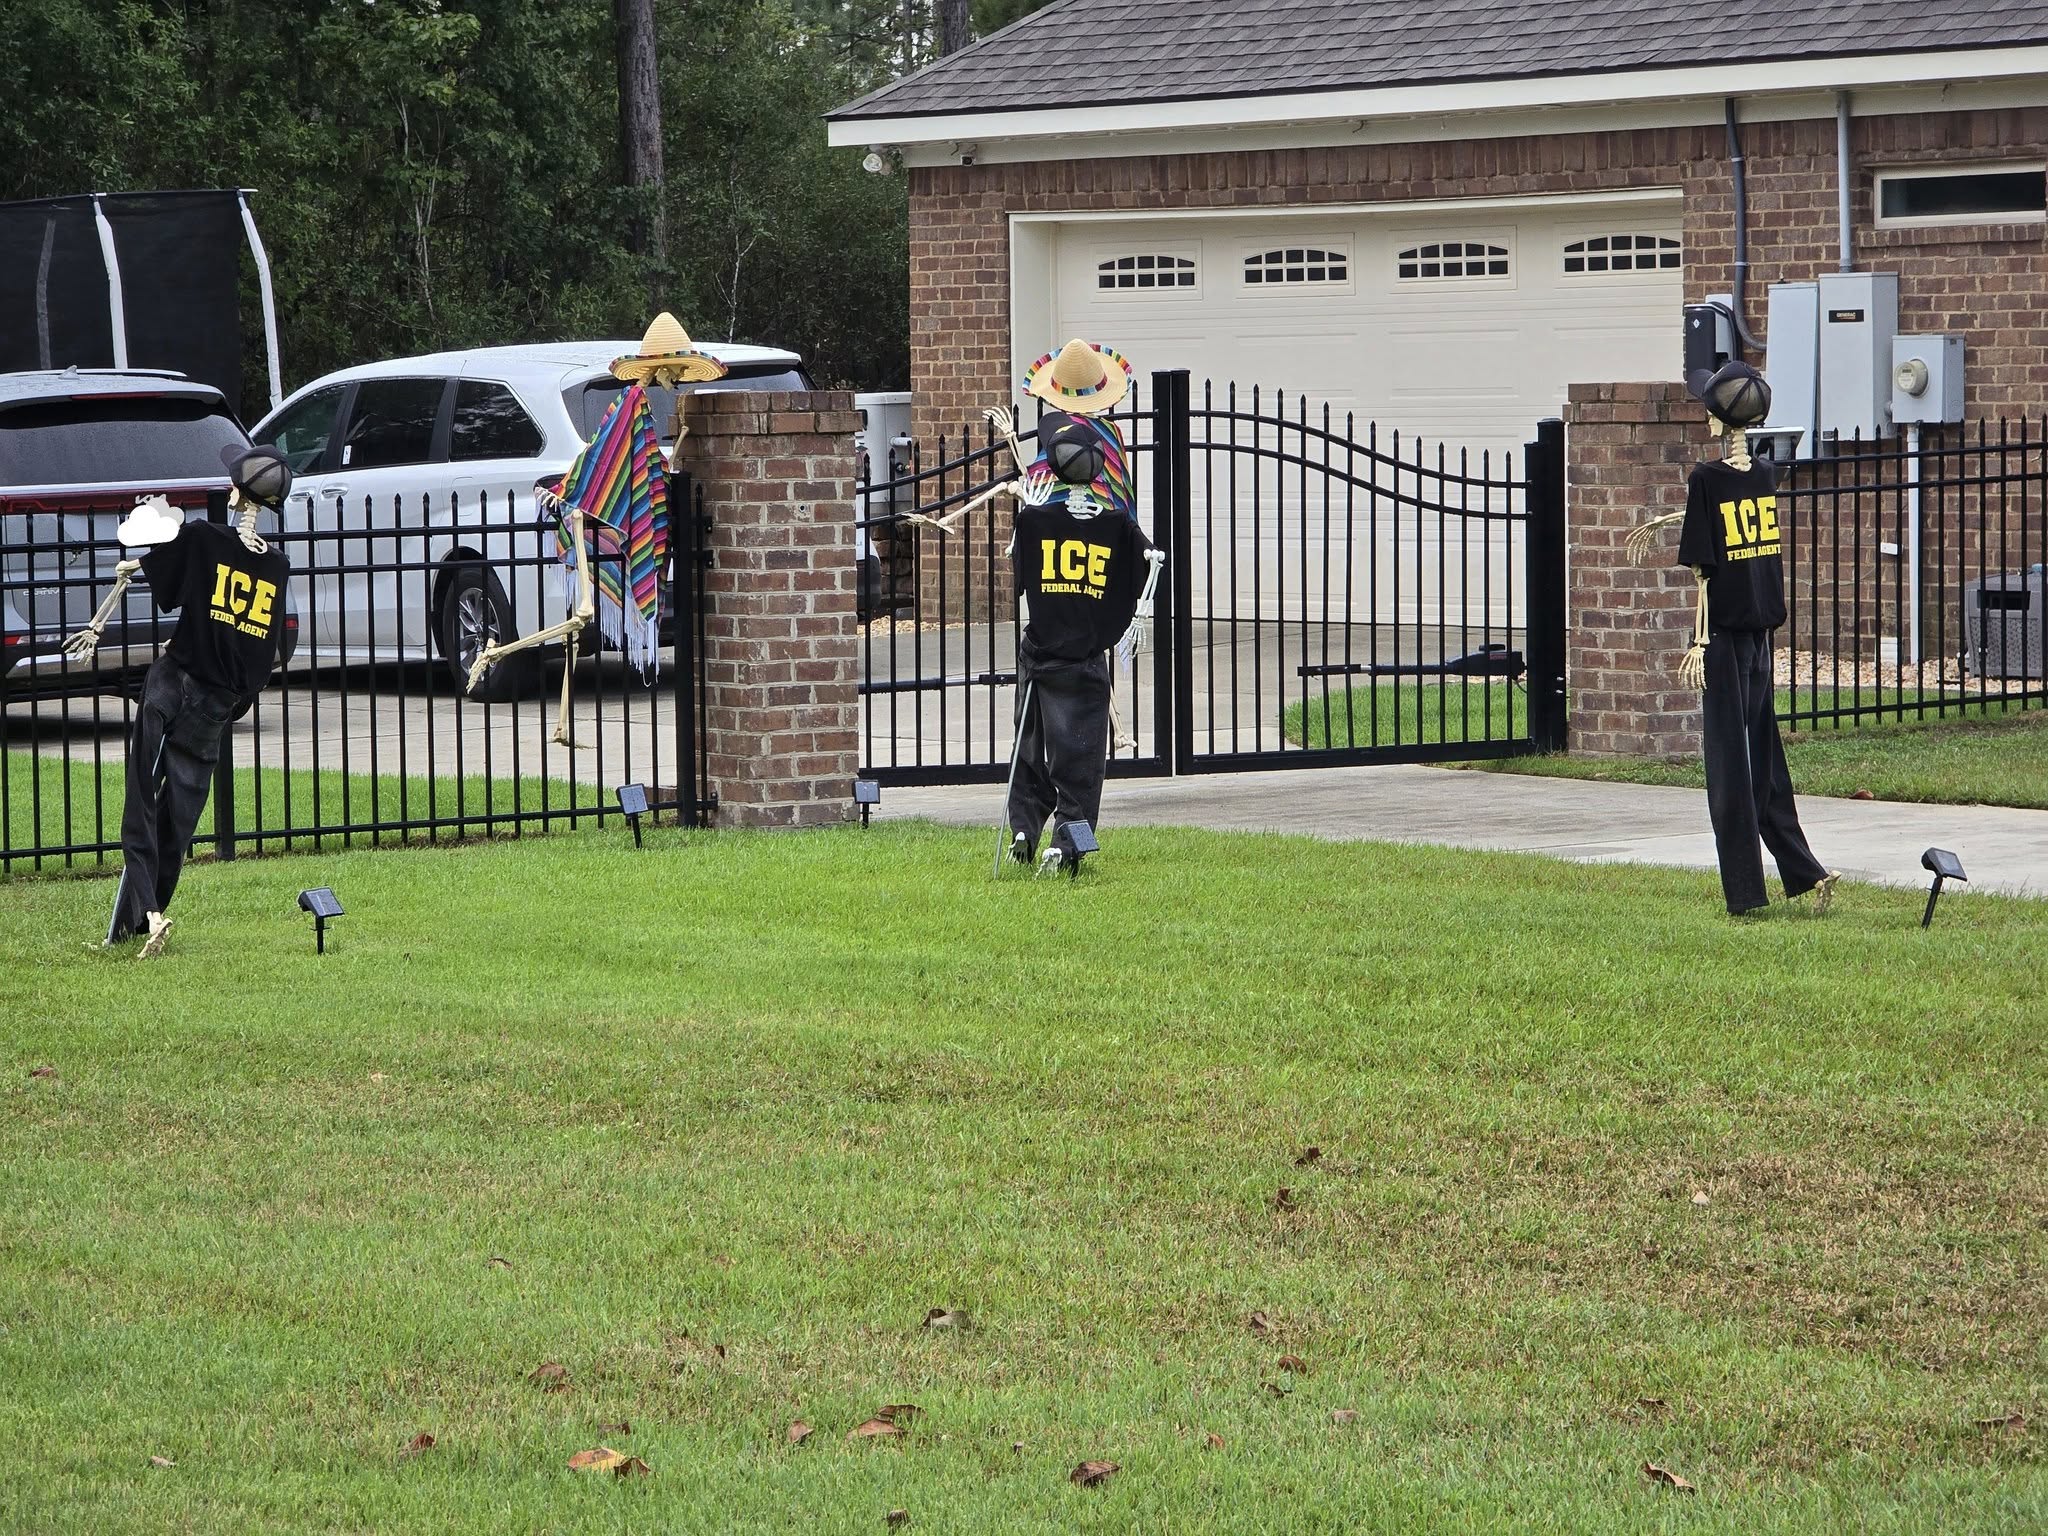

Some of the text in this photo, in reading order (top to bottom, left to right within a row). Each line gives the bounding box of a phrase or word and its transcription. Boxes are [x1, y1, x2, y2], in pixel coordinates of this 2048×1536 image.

[1720, 496, 1780, 547] ICE
[1041, 540, 1111, 587] ICE
[1758, 544, 1781, 557] AGENT
[211, 563, 277, 626] ICE
[1041, 583, 1082, 594] FEDERAL
[210, 609, 268, 639] FEDER AGENT
